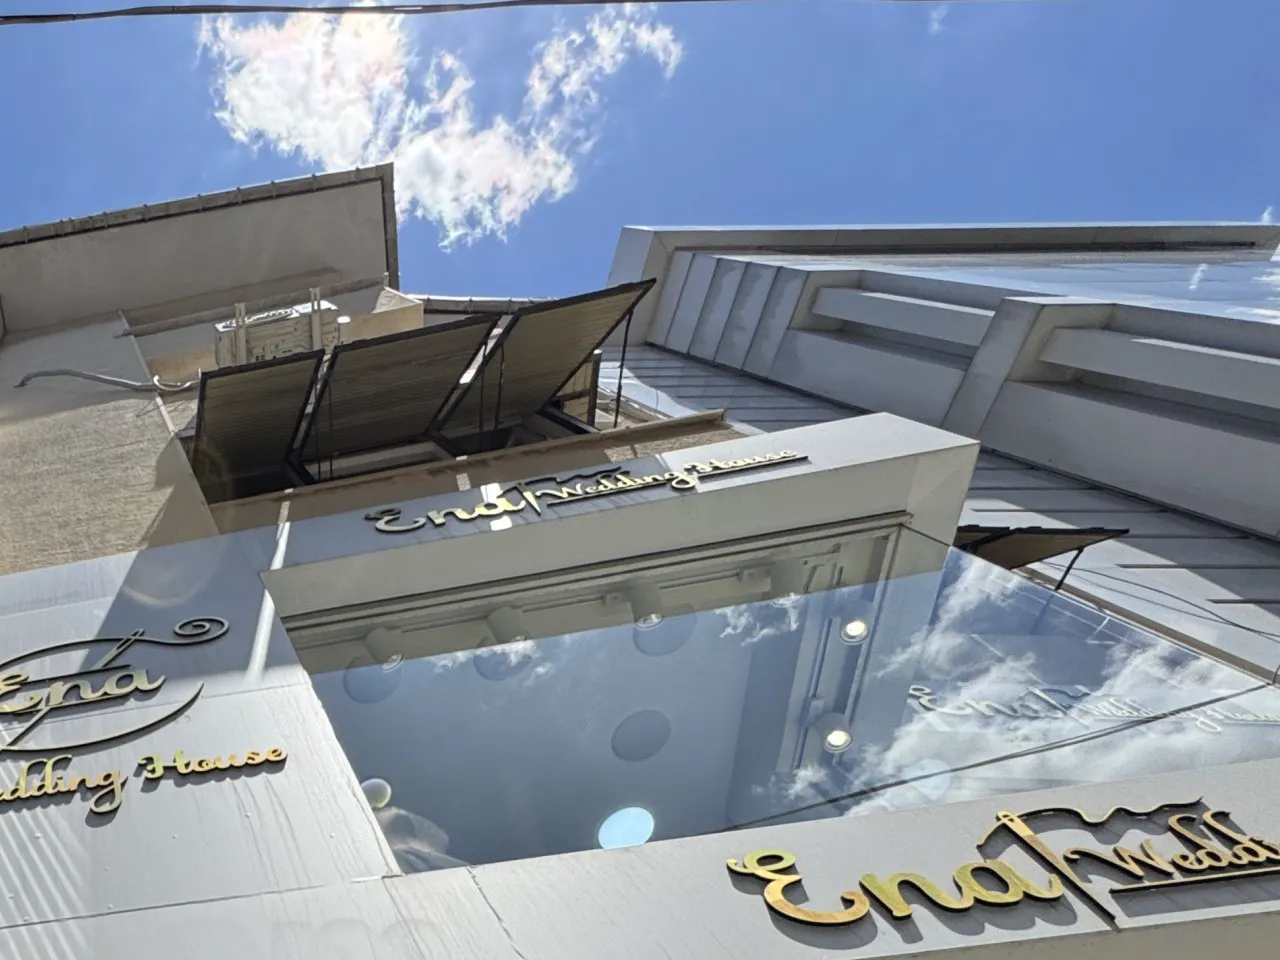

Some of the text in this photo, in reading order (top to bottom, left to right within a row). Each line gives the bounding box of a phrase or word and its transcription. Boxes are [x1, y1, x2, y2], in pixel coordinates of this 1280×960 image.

[364, 448, 798, 533] Ena Wedding House
[137, 744, 289, 780] House
[727, 849, 1064, 926] Ena
